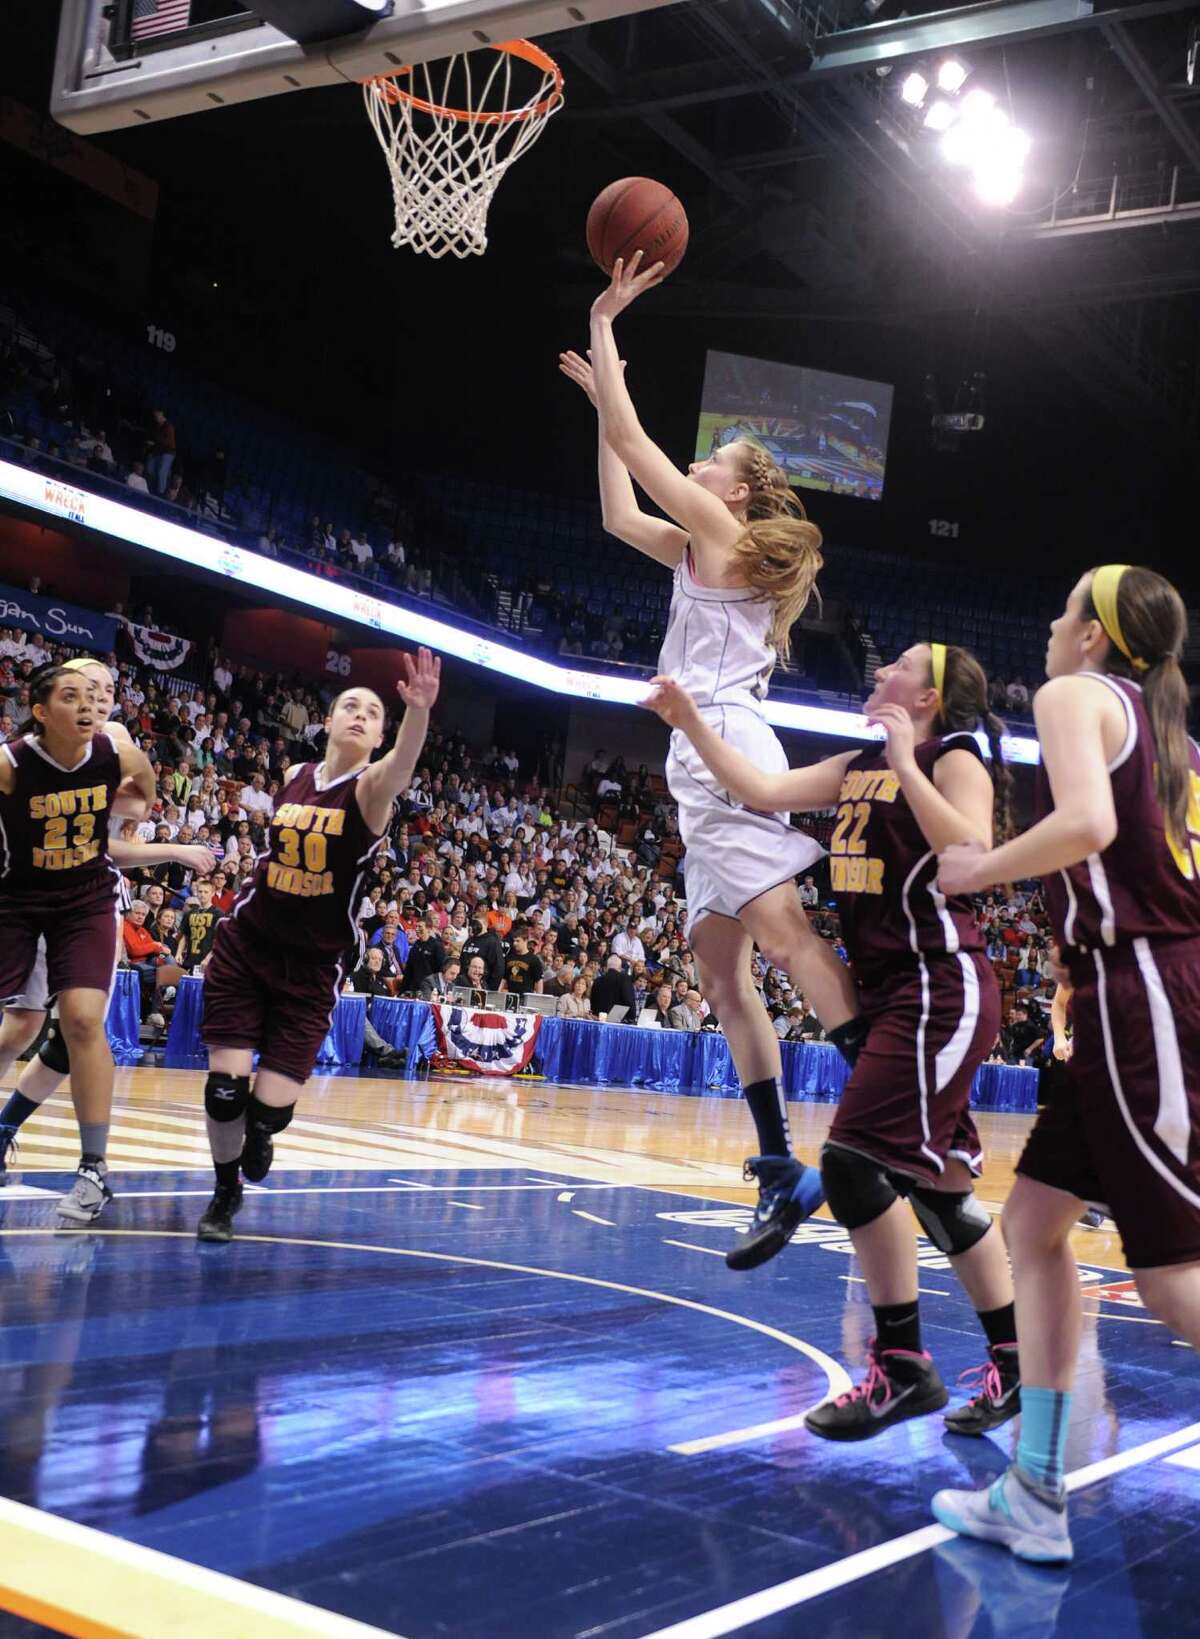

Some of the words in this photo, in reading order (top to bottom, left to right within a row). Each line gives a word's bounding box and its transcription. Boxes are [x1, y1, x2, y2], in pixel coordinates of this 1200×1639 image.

[147, 325, 176, 352] 119
[928, 519, 959, 538] 121
[45, 608, 93, 639] Sun
[325, 651, 351, 676] 26
[30, 785, 107, 819] SOUTH
[840, 769, 900, 803] SOUTH
[44, 813, 96, 849] 23
[272, 803, 345, 835] SOUTH
[831, 802, 871, 854] 22
[279, 828, 327, 872] 30
